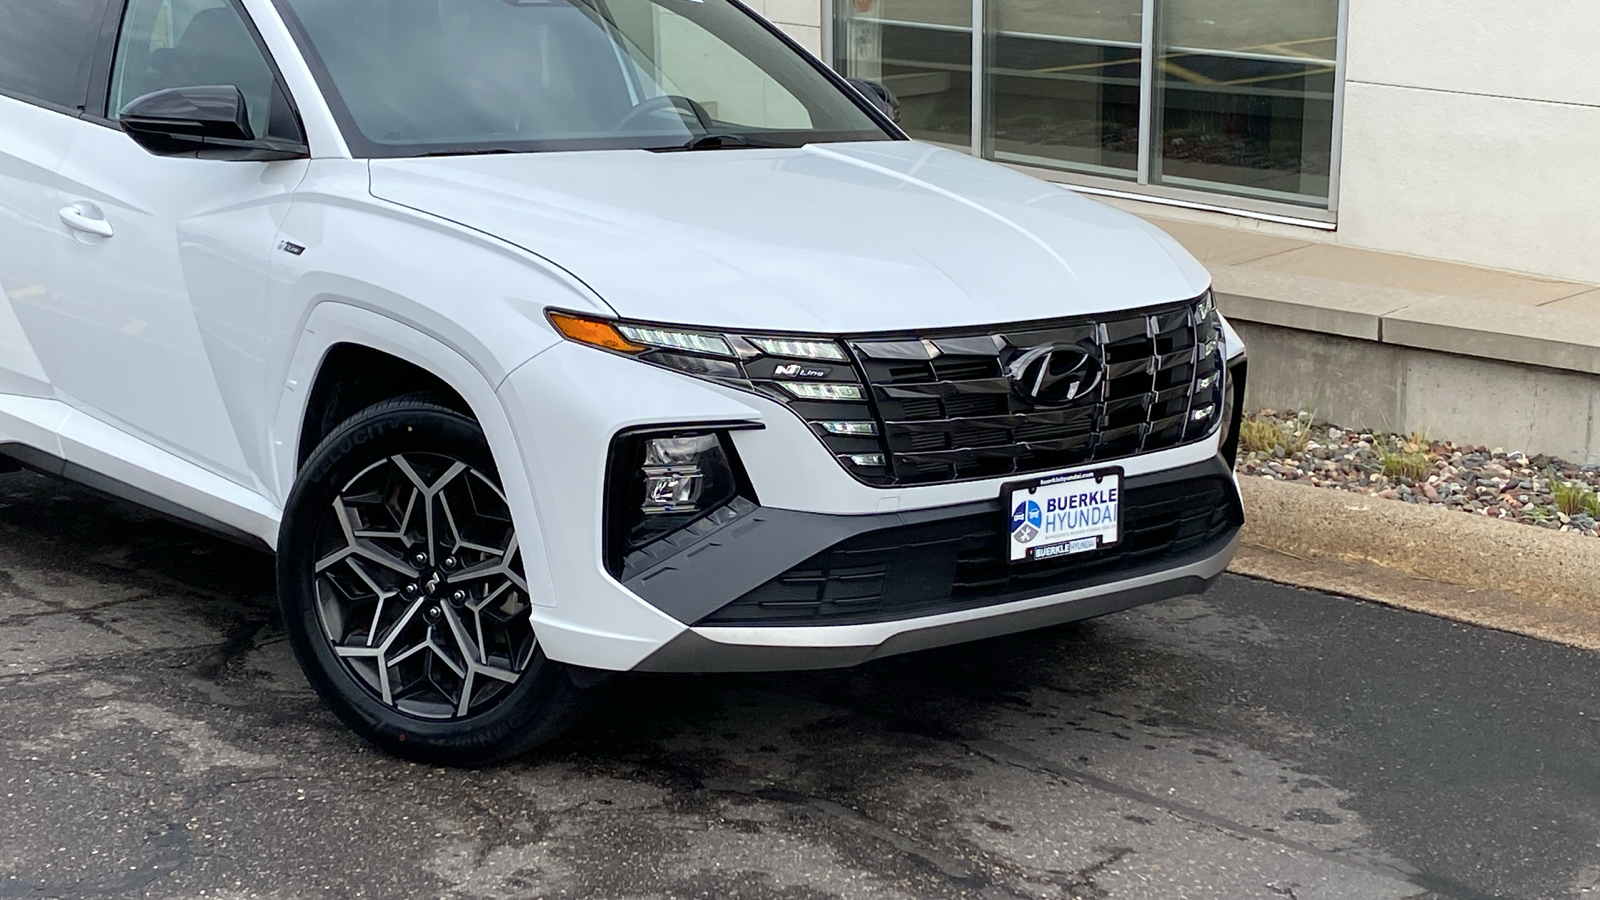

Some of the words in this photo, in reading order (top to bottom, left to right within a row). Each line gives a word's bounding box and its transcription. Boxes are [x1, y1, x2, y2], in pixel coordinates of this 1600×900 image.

[1047, 488, 1117, 513] BUERKLE
[1045, 503, 1117, 533] HYUNDAI
[1035, 543, 1070, 558] BUERKLE
